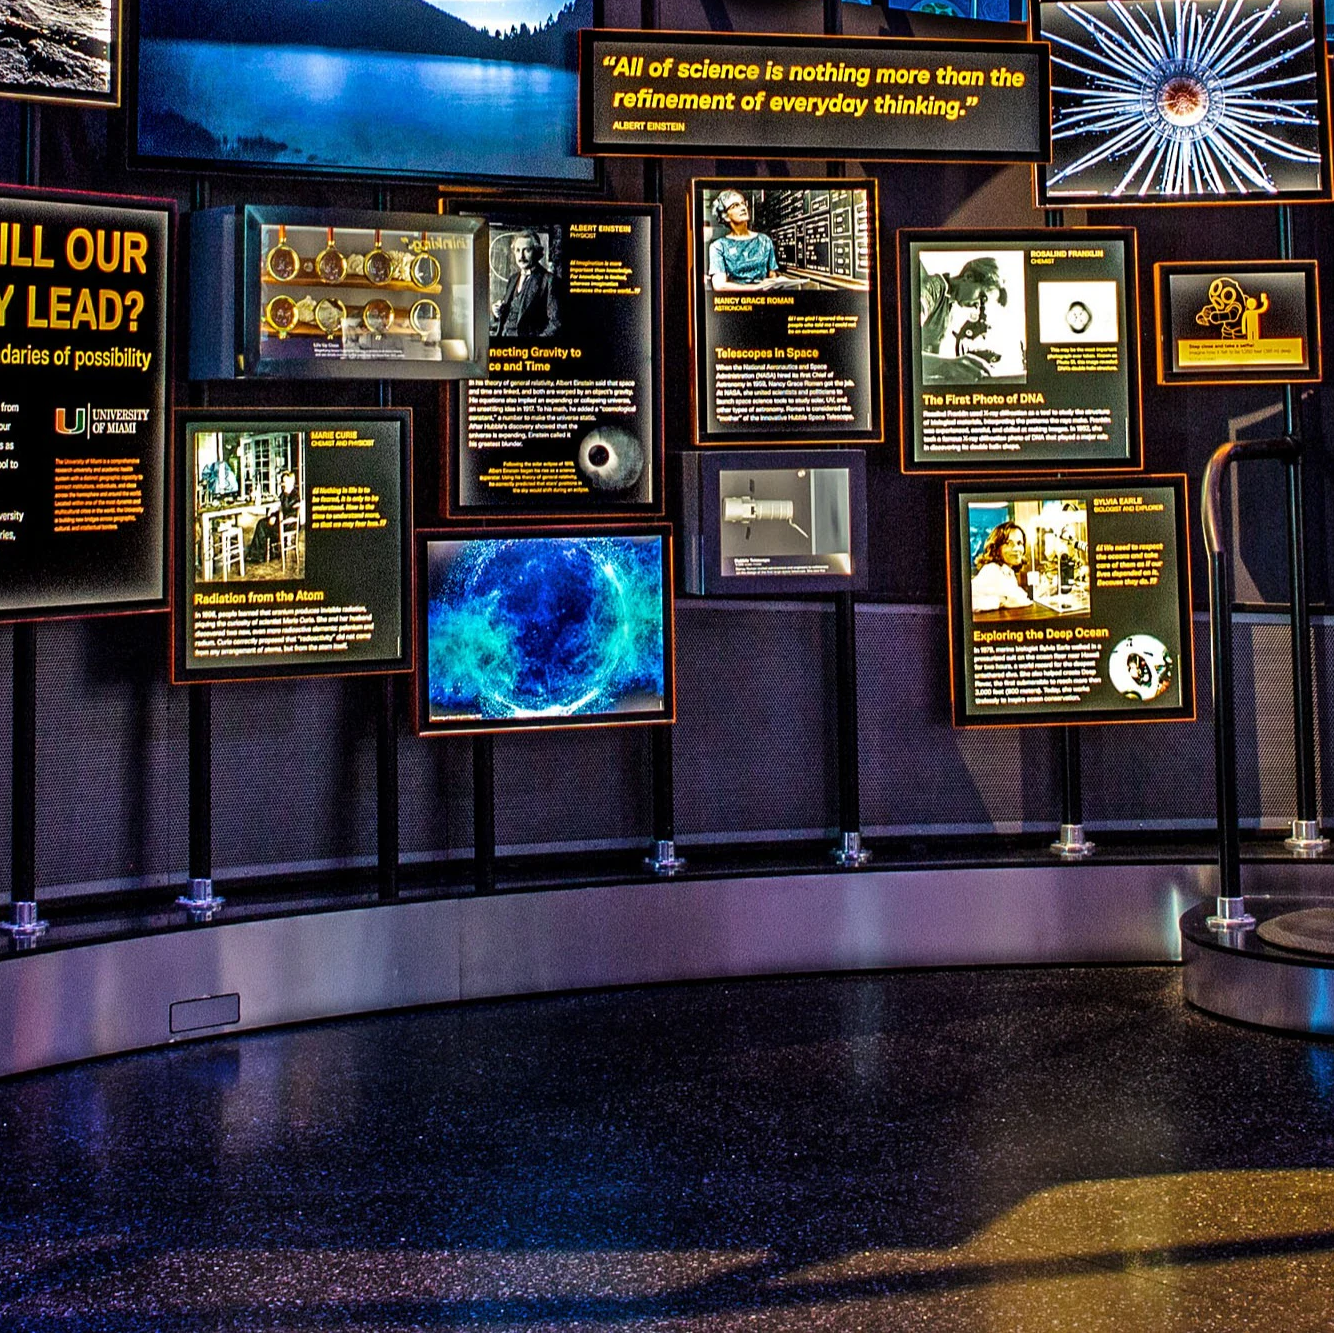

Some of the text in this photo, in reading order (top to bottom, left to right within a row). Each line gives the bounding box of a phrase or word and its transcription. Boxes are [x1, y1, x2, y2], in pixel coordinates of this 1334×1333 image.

[603, 56, 1025, 87] “All of science is nothing more than the
[613, 89, 979, 120] refinement of everyday thinking.”
[66, 229, 148, 273] OUR
[1030, 250, 1104, 258] ROSALIND FRANKLIN
[714, 297, 795, 305] NANCY GRACE ROMAN
[27, 287, 144, 330] LEAD?
[53, 346, 71, 365] of
[74, 347, 152, 371] possibility
[489, 347, 582, 359] necting Gravity to
[715, 347, 819, 360] Telescopes in Space
[503, 361, 523, 371] and
[524, 361, 551, 371] Time
[922, 393, 1045, 406] The First Photo of DNA
[0, 401, 20, 412] from
[92, 408, 150, 421] UNIVERSITY
[92, 422, 137, 434] OF MIAMI
[310, 431, 358, 440] MARIE CURIE
[1093, 497, 1143, 506] SYLVIA EARLE
[194, 590, 324, 605] Radiation from the Atom
[973, 628, 1109, 641] Exploring the Deep Ocean
